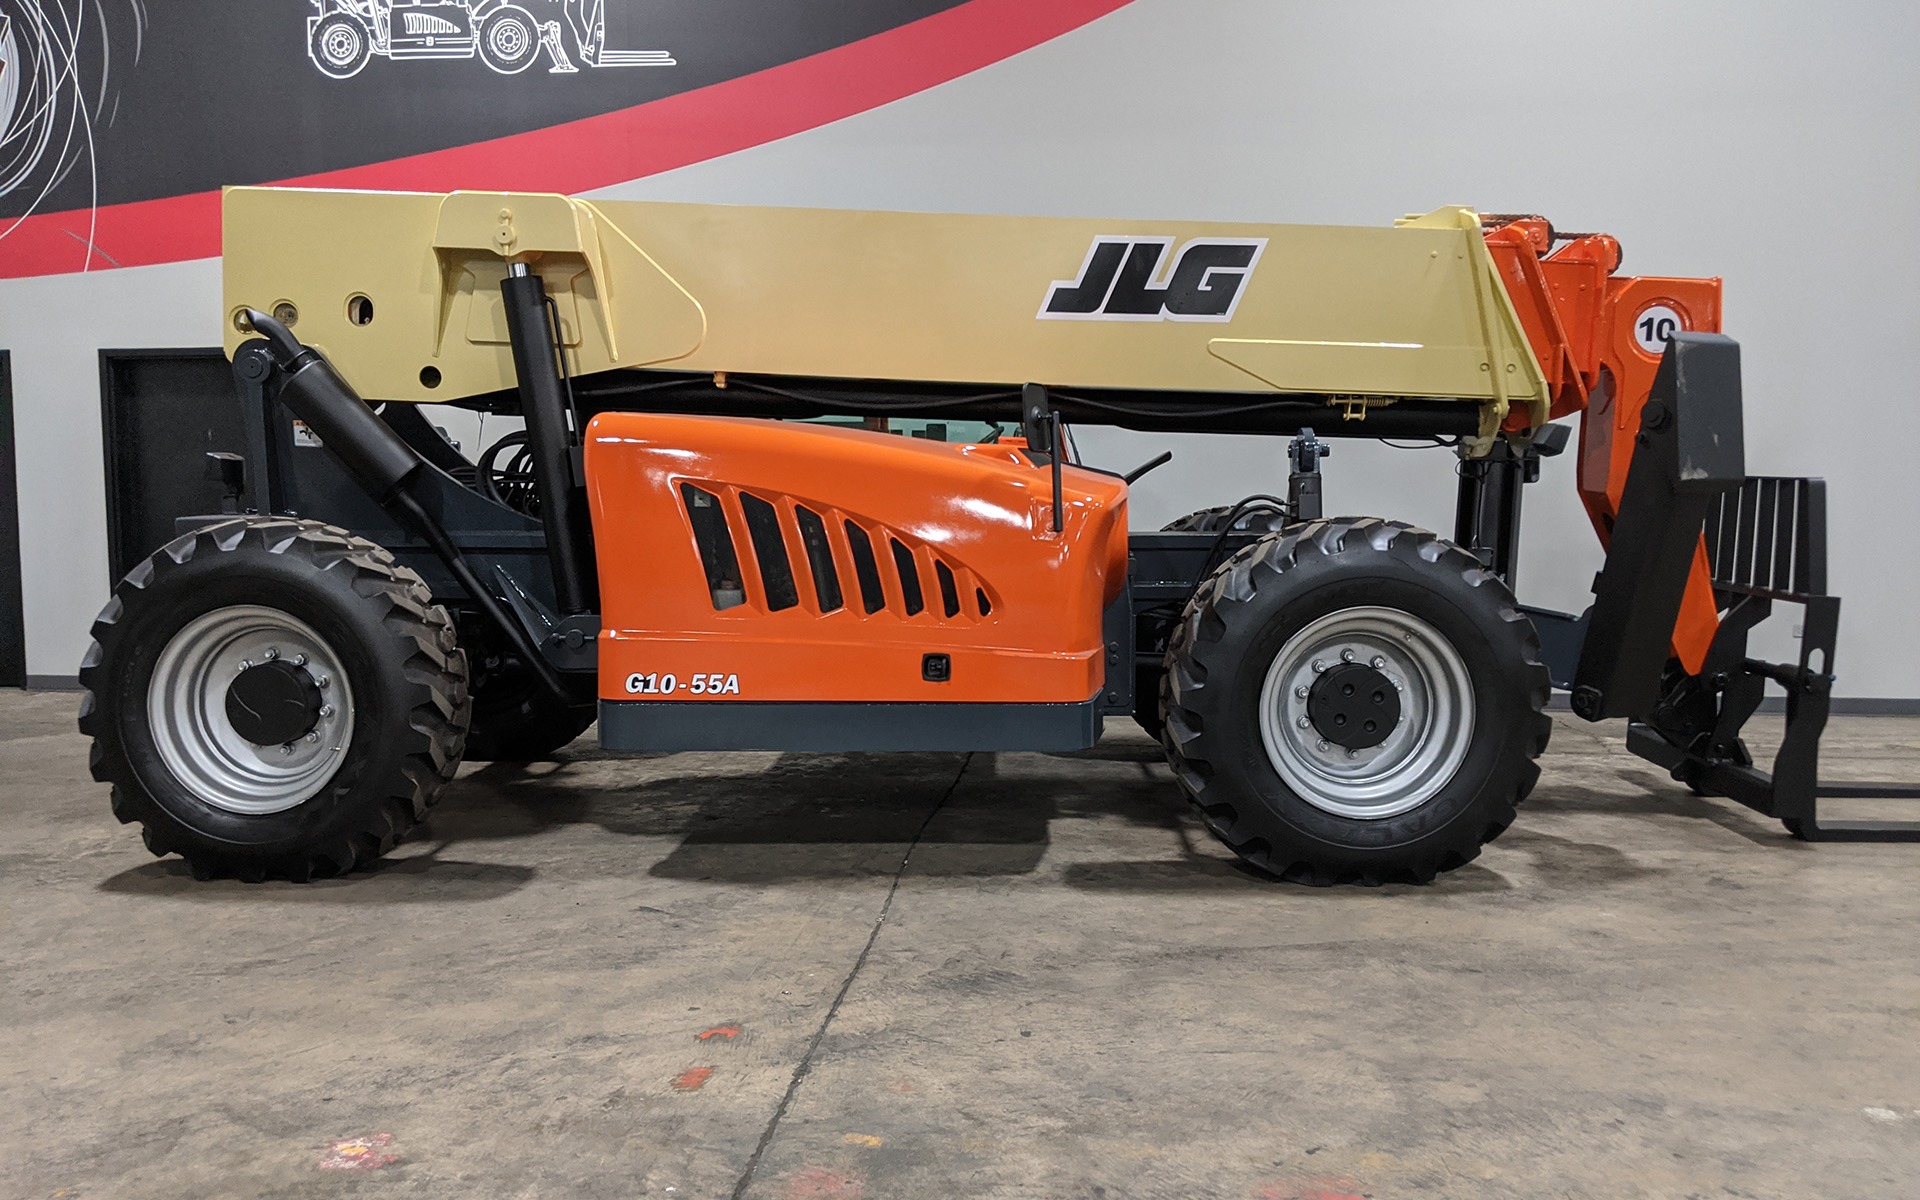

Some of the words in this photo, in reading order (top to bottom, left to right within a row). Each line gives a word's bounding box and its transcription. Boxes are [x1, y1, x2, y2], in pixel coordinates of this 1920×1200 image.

[1040, 237, 1264, 319] JLG
[1639, 317, 1676, 342] 10
[625, 672, 740, 694] G10-55A
